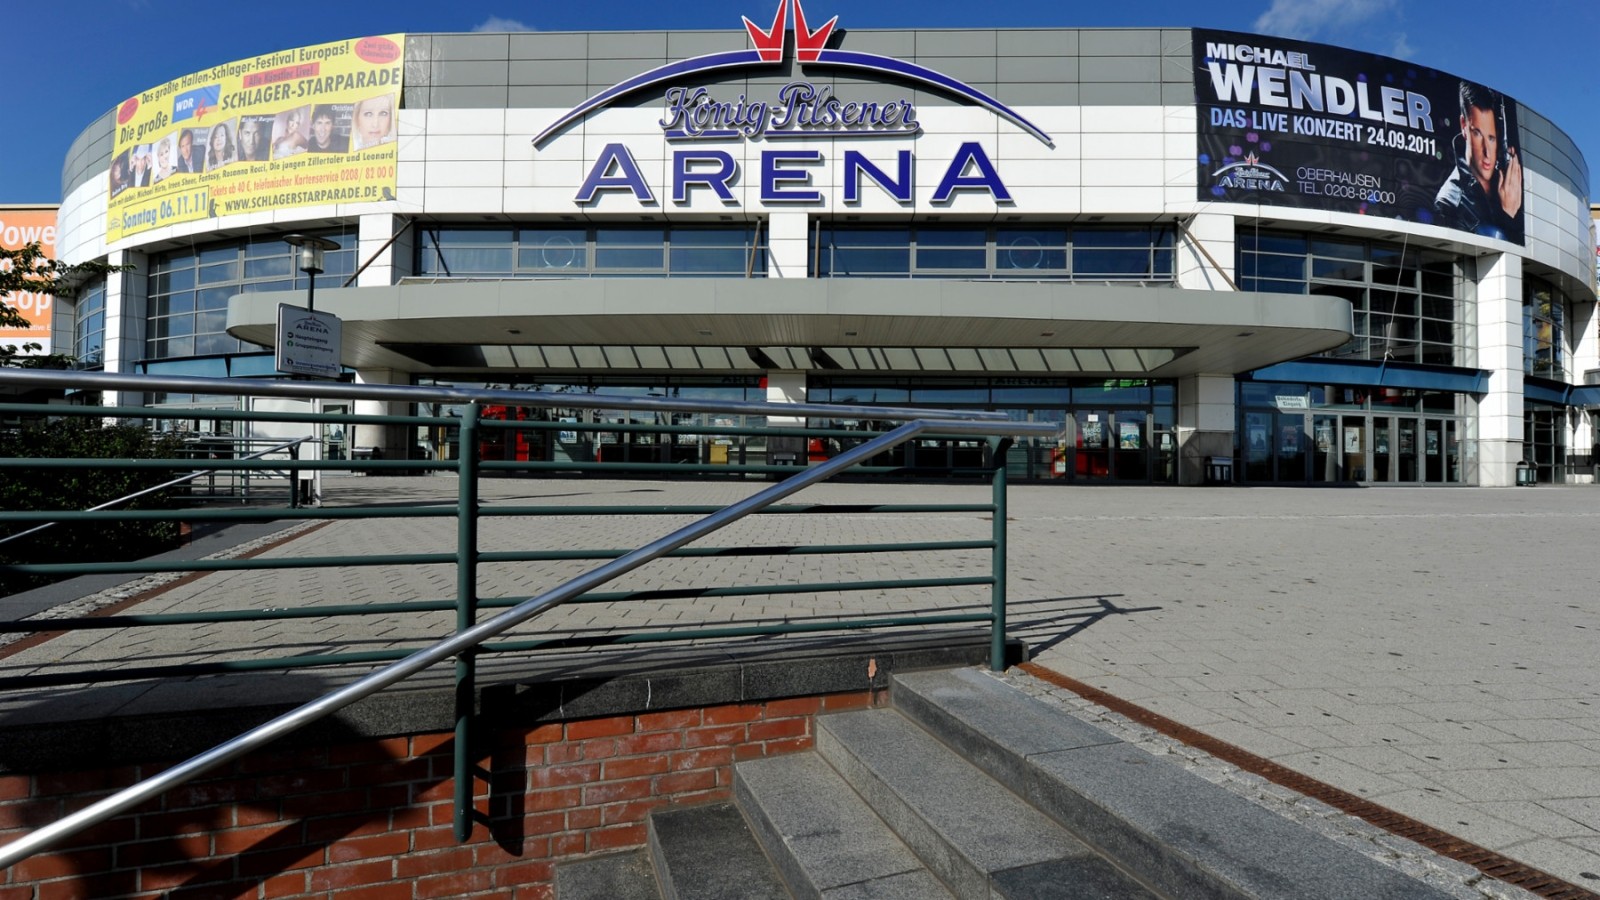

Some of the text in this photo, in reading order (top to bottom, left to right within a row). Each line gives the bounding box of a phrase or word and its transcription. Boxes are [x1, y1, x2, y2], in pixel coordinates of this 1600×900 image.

[1206, 42, 1316, 71] MICHAEL
[142, 41, 349, 105] Das größte Hallen-Schlager-Festival Europas!
[119, 125, 135, 145] Die
[137, 110, 168, 141] große
[175, 97, 194, 112] WDR
[221, 67, 400, 110] SCHLAGER-STARPARADE
[658, 80, 922, 138] König-Pilsener
[1207, 62, 1435, 133] WENDLER
[1210, 106, 1436, 156] DAS LIVE KONZERT 24.09.2011
[269, 161, 280, 170] Die
[281, 159, 306, 172] jungen
[307, 155, 344, 167] Zillertaler
[346, 152, 360, 162] und
[363, 150, 394, 161] Leonard
[573, 141, 1016, 205] ARENA
[228, 185, 236, 195] ab
[294, 171, 339, 186] Kartenservice
[365, 166, 375, 180] 82
[388, 165, 394, 178] 0
[1218, 175, 1285, 192] ARENA
[1296, 166, 1381, 189] OBERHAUSEN
[225, 185, 378, 212] WWW.SCHLAGERSTARPARADE.DE
[1296, 181, 1396, 205] TEL. 0208-82000
[122, 208, 157, 230] Sonntag
[160, 192, 207, 219] 06.11.11
[296, 323, 328, 334] ARENA
